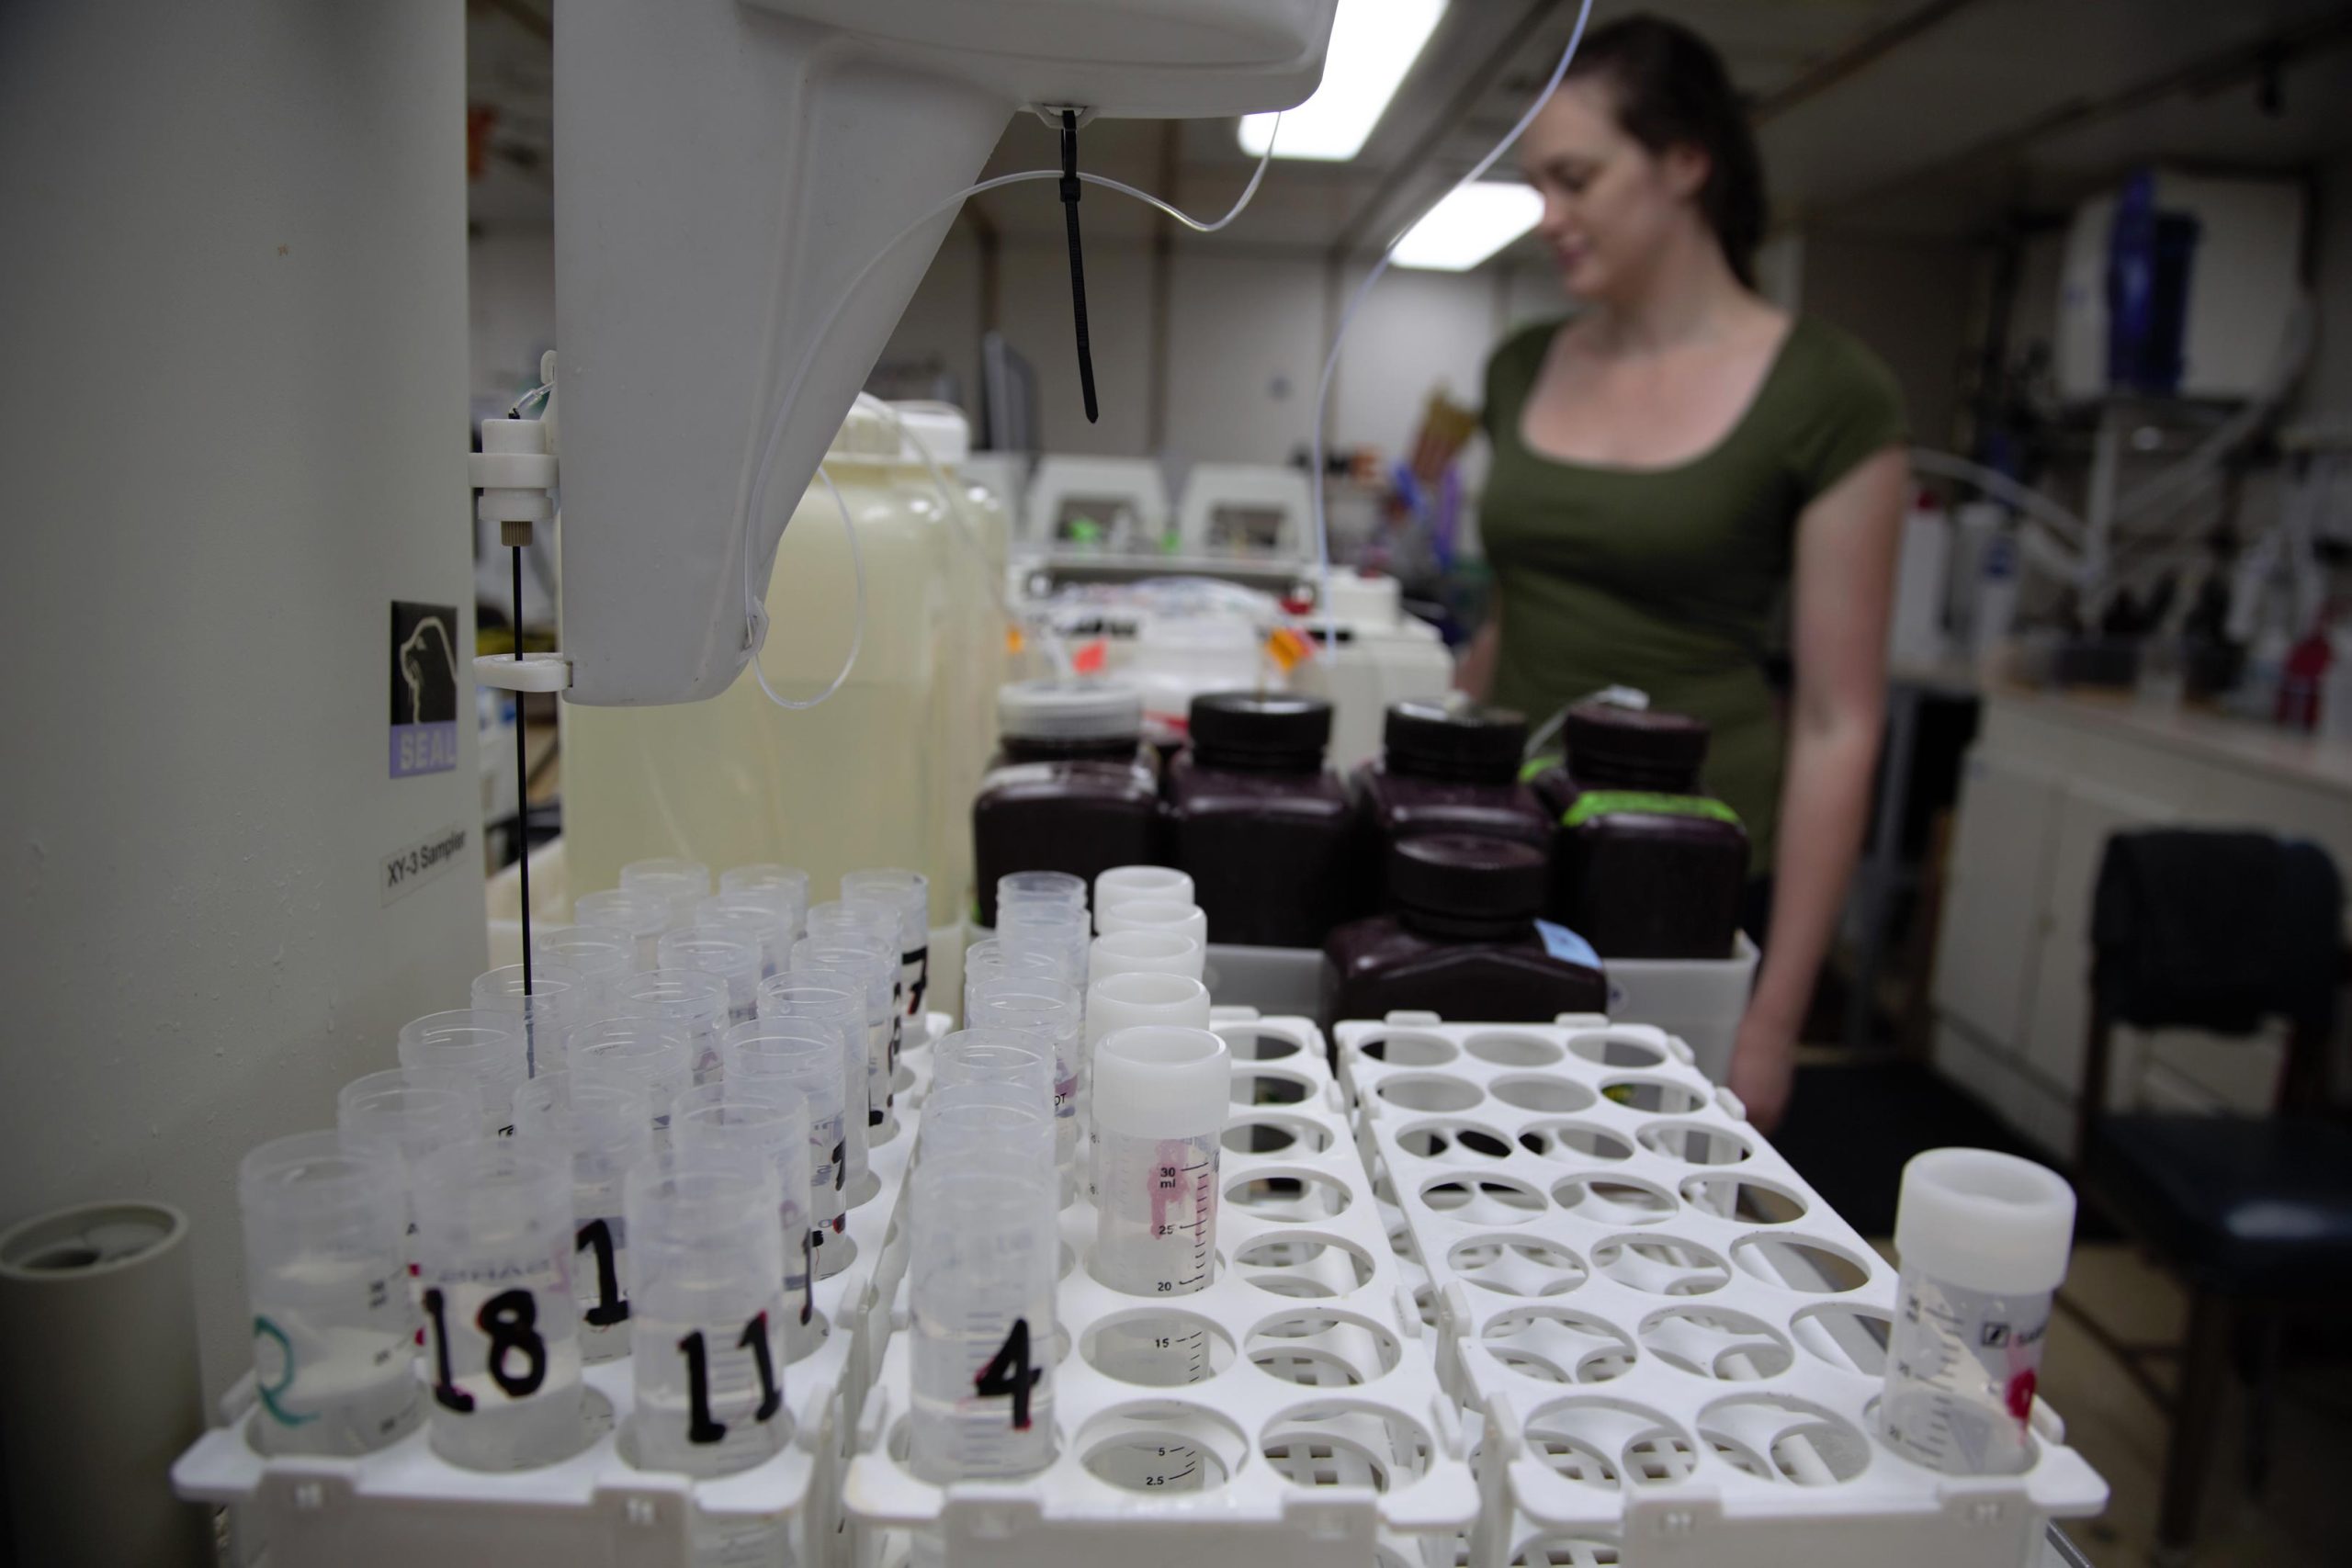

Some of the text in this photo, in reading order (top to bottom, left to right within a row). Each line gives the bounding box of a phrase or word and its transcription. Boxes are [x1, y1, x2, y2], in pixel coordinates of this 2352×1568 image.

[400, 731, 457, 771] SEAL
[388, 830, 466, 887] XY-3 Sampler
[1160, 1168, 1176, 1178] 30
[1160, 1179, 1176, 1188] ml
[1159, 1224, 1173, 1235] 25
[1157, 1281, 1171, 1292] 20
[1155, 1337, 1170, 1348] 15
[423, 1289, 547, 1413] 18
[678, 1310, 783, 1443] 11
[973, 1318, 1043, 1431] 4
[1158, 1448, 1166, 1456] 5
[1146, 1476, 1164, 1486] 2.5
